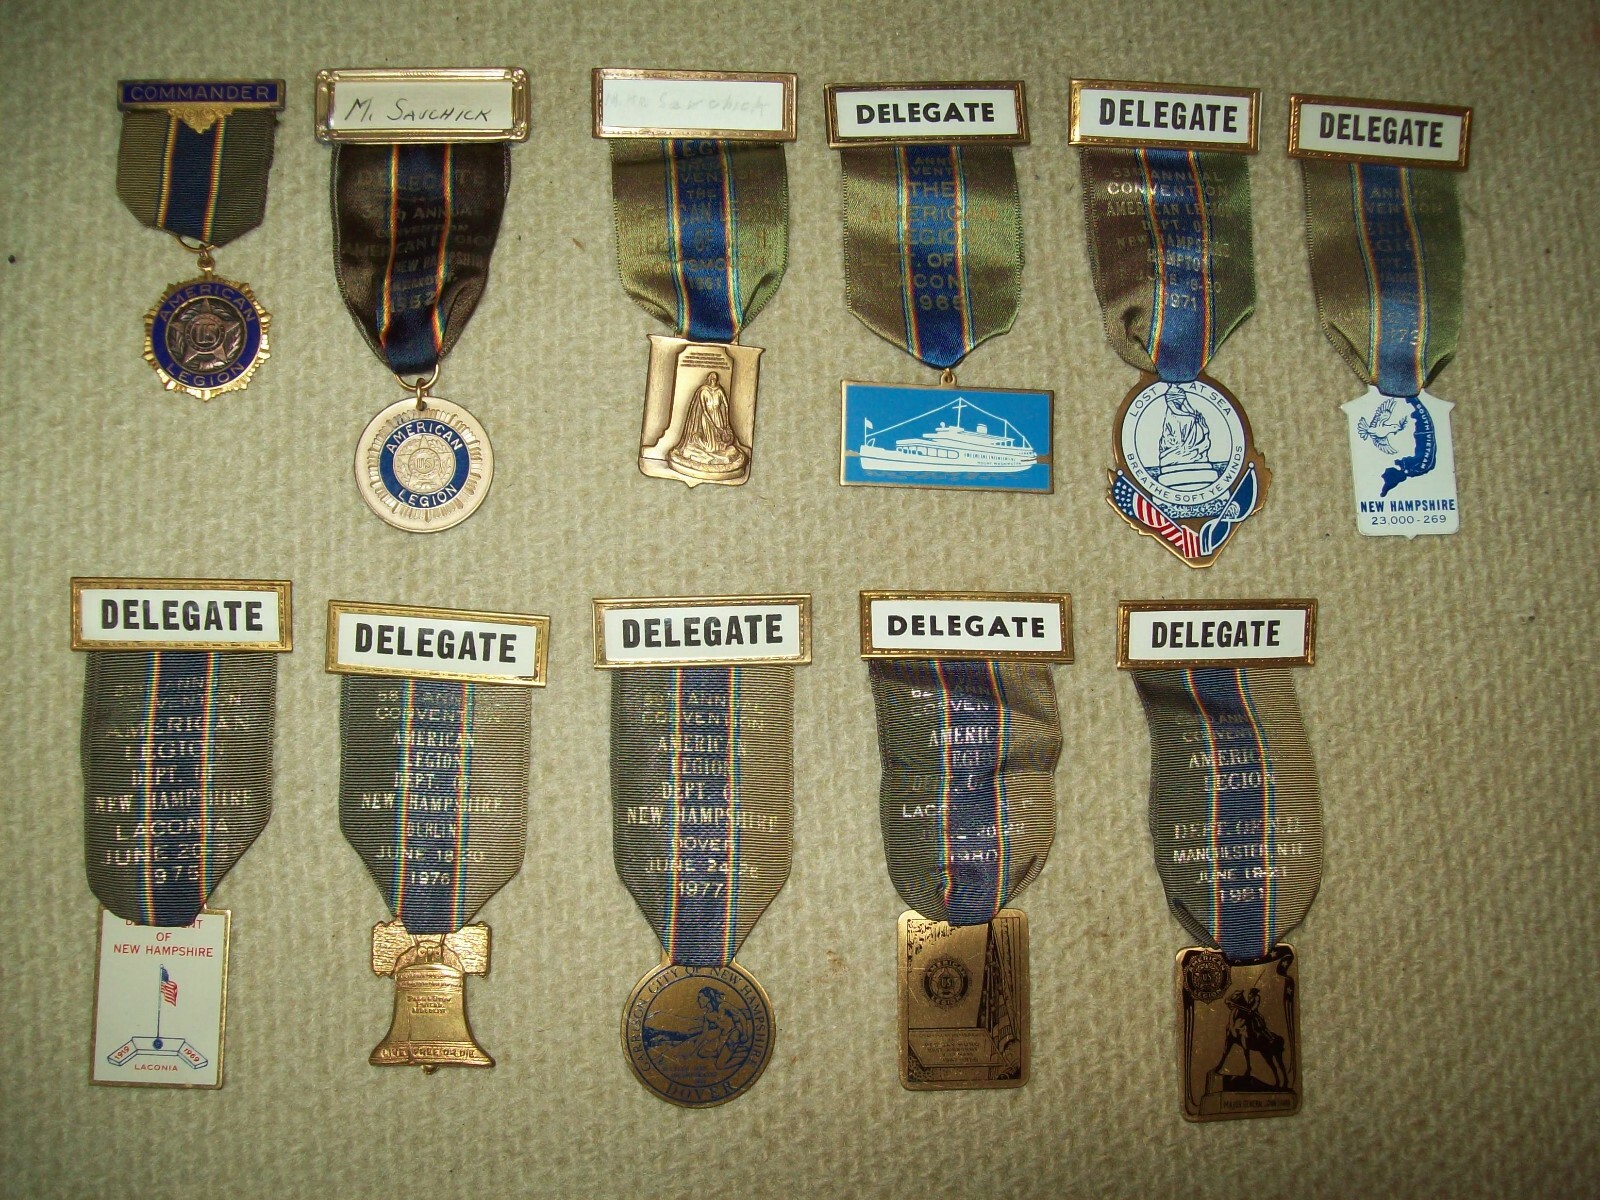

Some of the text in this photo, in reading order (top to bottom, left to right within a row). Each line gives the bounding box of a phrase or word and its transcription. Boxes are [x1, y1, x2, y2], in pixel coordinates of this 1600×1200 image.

[131, 83, 269, 100] COMMANDER
[856, 102, 995, 124] DELEGATE
[1099, 98, 1237, 133] DELEGATE
[1319, 112, 1444, 148] DELEGATE
[1152, 169, 1224, 182] ANNAL
[908, 182, 955, 198] THE
[1107, 183, 1228, 197] CONVENTON
[1107, 201, 1179, 216] AMERCAN
[375, 224, 469, 239] CONVENTON
[1142, 220, 1186, 231] DPT.
[889, 228, 974, 246] LEGIO
[344, 237, 428, 258] AMERCAN
[927, 253, 955, 267] OF
[1147, 248, 1206, 272] HMPTO
[885, 274, 992, 289] LACONA
[160, 283, 255, 322] AMERICAN
[919, 294, 963, 311] 965
[166, 363, 245, 387] LEGION
[1130, 382, 1231, 417] LOST AT SEA
[386, 422, 463, 454] AMERICAN
[1416, 404, 1433, 469] SOUTH VIETNAM
[416, 458, 432, 469] US
[1127, 445, 1243, 503] BREATHE SOFT YE WINDS
[398, 484, 457, 507] LEGION
[1360, 499, 1456, 513] NEW HAMPSHIRE
[101, 599, 263, 631] DELEGATE
[622, 614, 783, 648] DELEGATE
[887, 615, 1045, 638] DELEGATE
[1151, 620, 1280, 648] DELEGATE
[355, 622, 517, 663] DELEGATE
[376, 707, 501, 723] CONVENTON
[641, 711, 765, 731] COVENTON
[658, 735, 746, 756] AMERICN
[928, 727, 996, 747] AMERIC
[125, 740, 223, 761] LEGIO
[131, 765, 183, 786] DPT.
[394, 773, 440, 789] DEPT.
[662, 782, 711, 799] DEPT.
[95, 789, 252, 814] NEW HAMPHIRE
[361, 794, 395, 809] NEW
[626, 807, 664, 825] NEW
[116, 818, 230, 841] LACONA
[102, 846, 169, 866] JUNE
[153, 866, 200, 884] 975
[645, 859, 697, 874] JUNE
[410, 871, 451, 885] 1976
[678, 881, 725, 898] 1977
[156, 932, 172, 942] OF
[114, 944, 213, 957] NEW HAMPSHIRE
[1189, 955, 1226, 972] AMERICAN
[648, 968, 678, 994] CITY
[711, 966, 741, 984] NEW
[740, 985, 766, 1066] HAMPSHIRE
[114, 1046, 200, 1062] 1919 1969
[135, 1064, 178, 1072] LACONIA
[665, 1081, 736, 1100] DOVER
